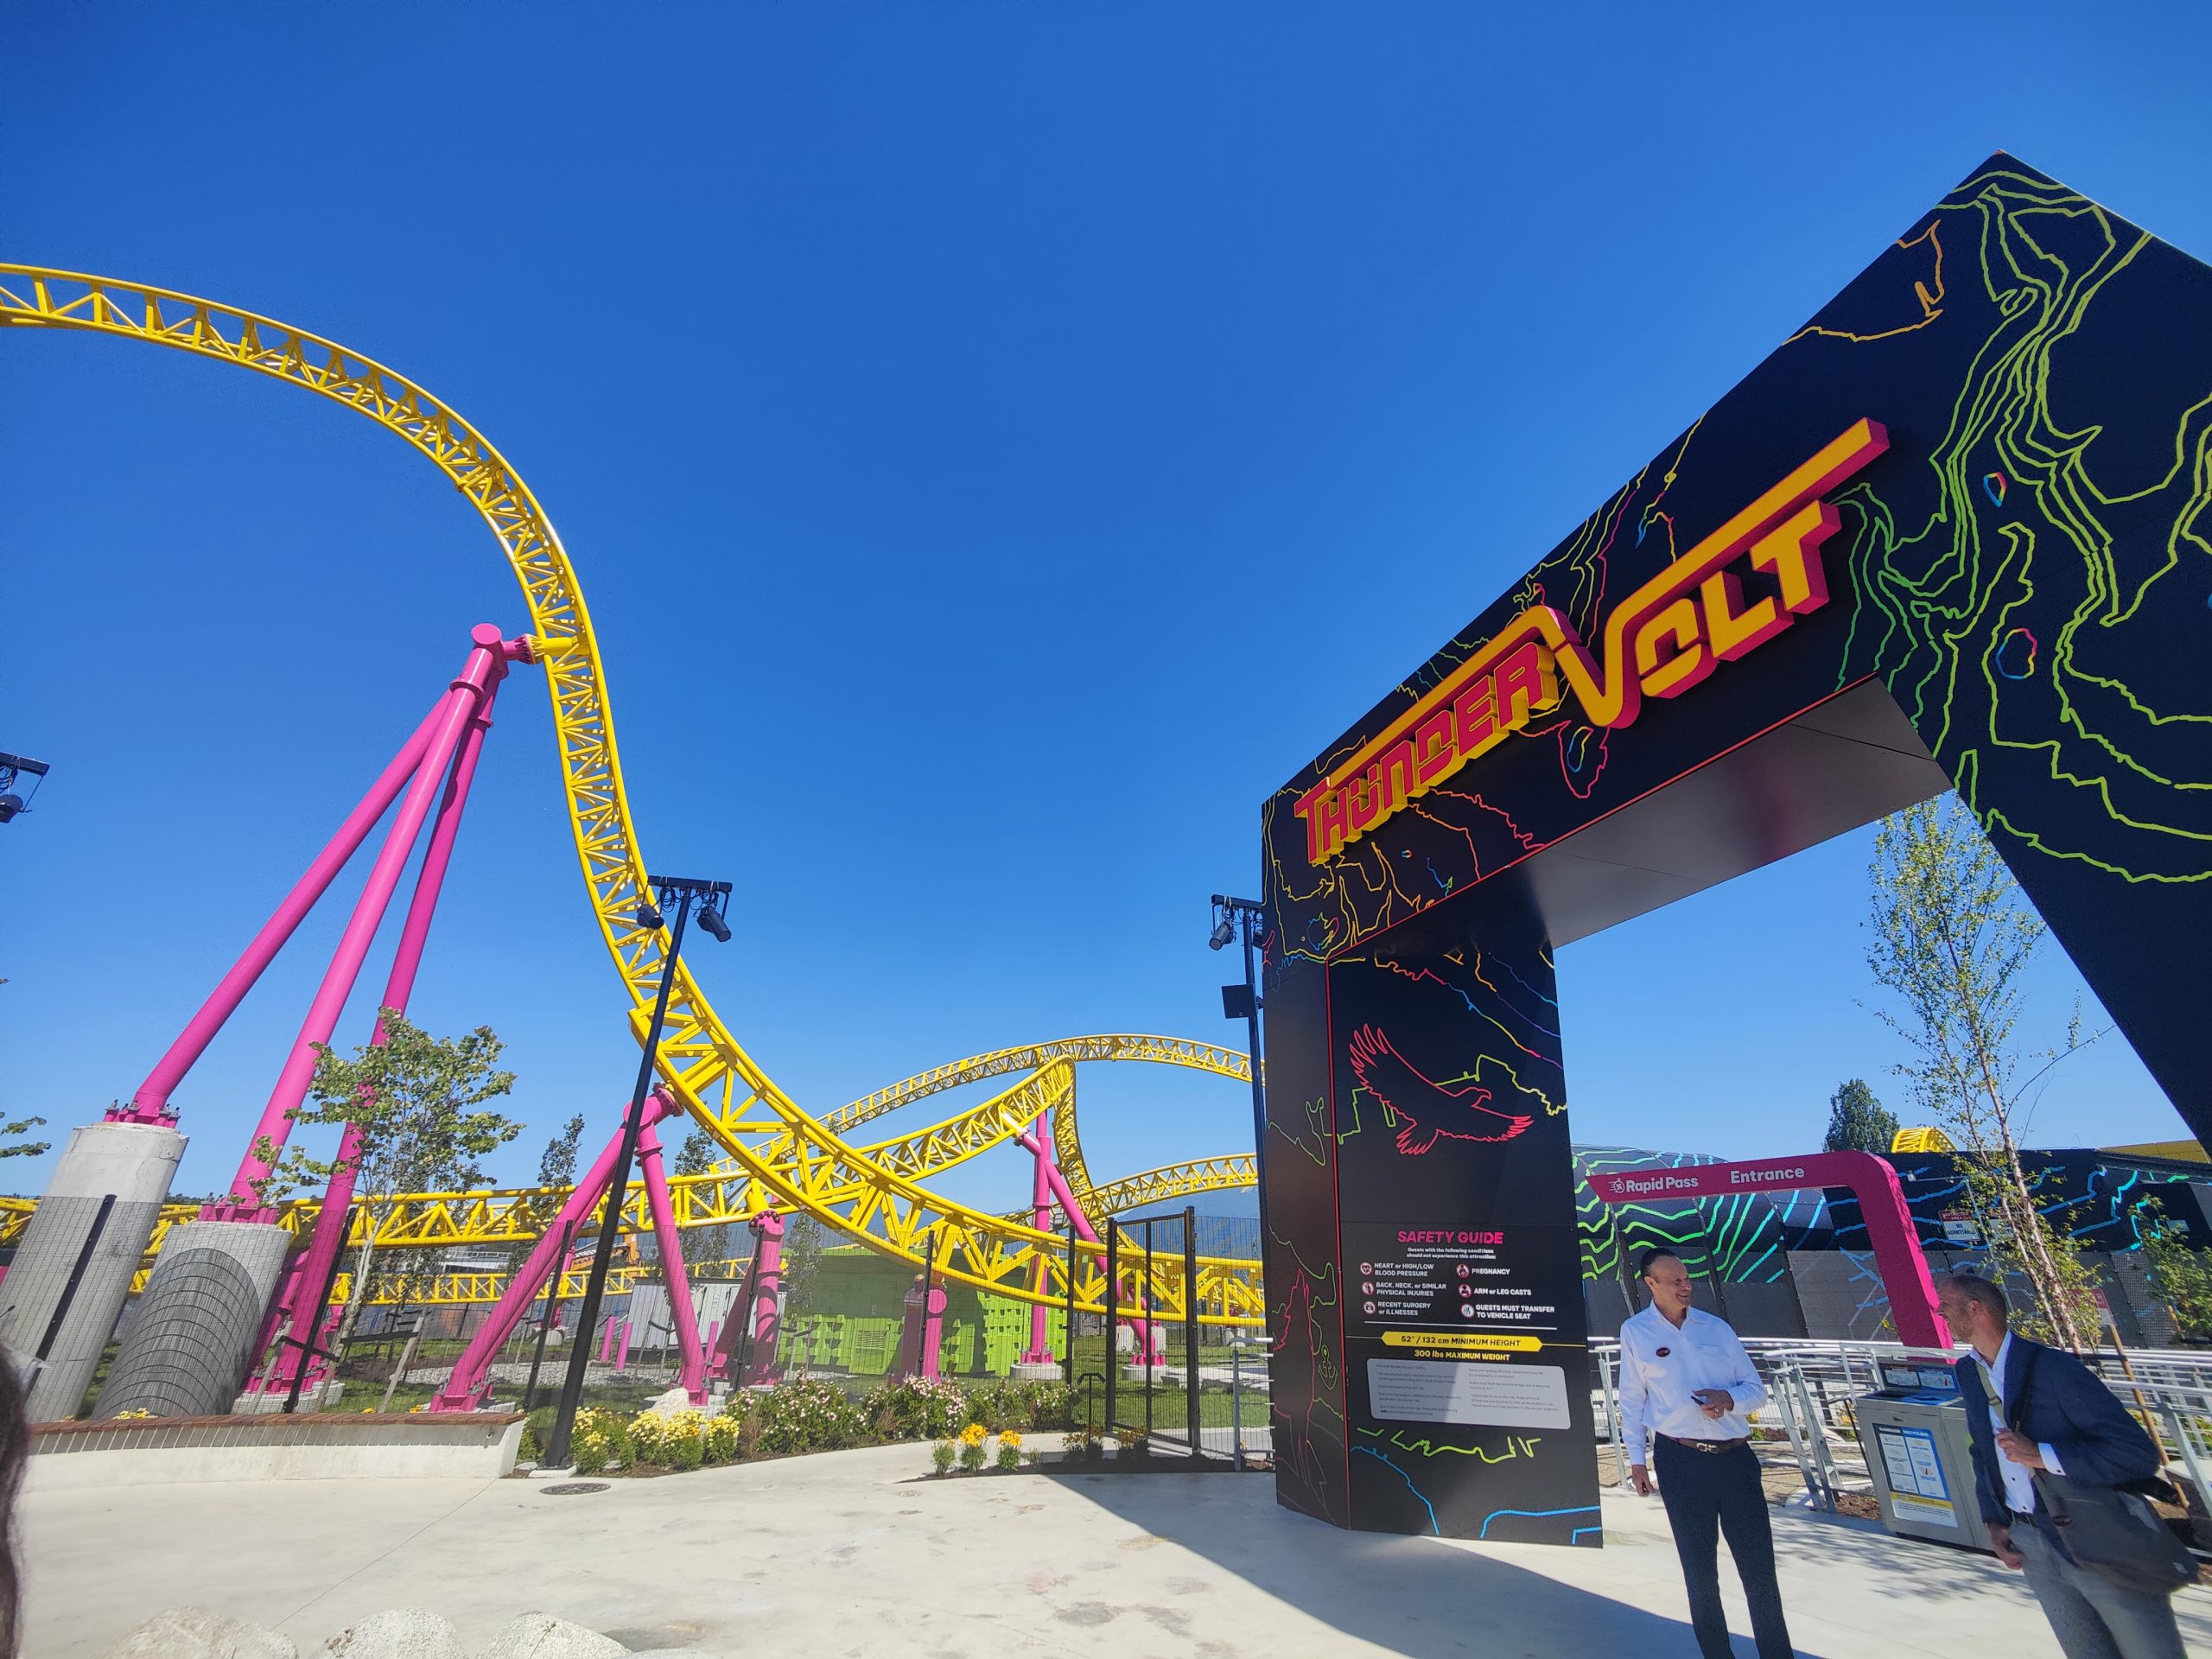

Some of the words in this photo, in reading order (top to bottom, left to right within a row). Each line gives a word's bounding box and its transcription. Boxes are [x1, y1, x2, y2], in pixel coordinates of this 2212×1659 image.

[1625, 1177, 1664, 1194] Rapid
[1666, 1176, 1699, 1189] Pass
[1731, 1166, 1805, 1184] Entrance
[1397, 1230, 1454, 1243] SAFETY
[1457, 1231, 1504, 1244] GUIDE
[1451, 1337, 1489, 1345] MINIMUM
[1432, 1350, 1444, 1358] lbs
[1445, 1351, 1481, 1360] MAXIMUM
